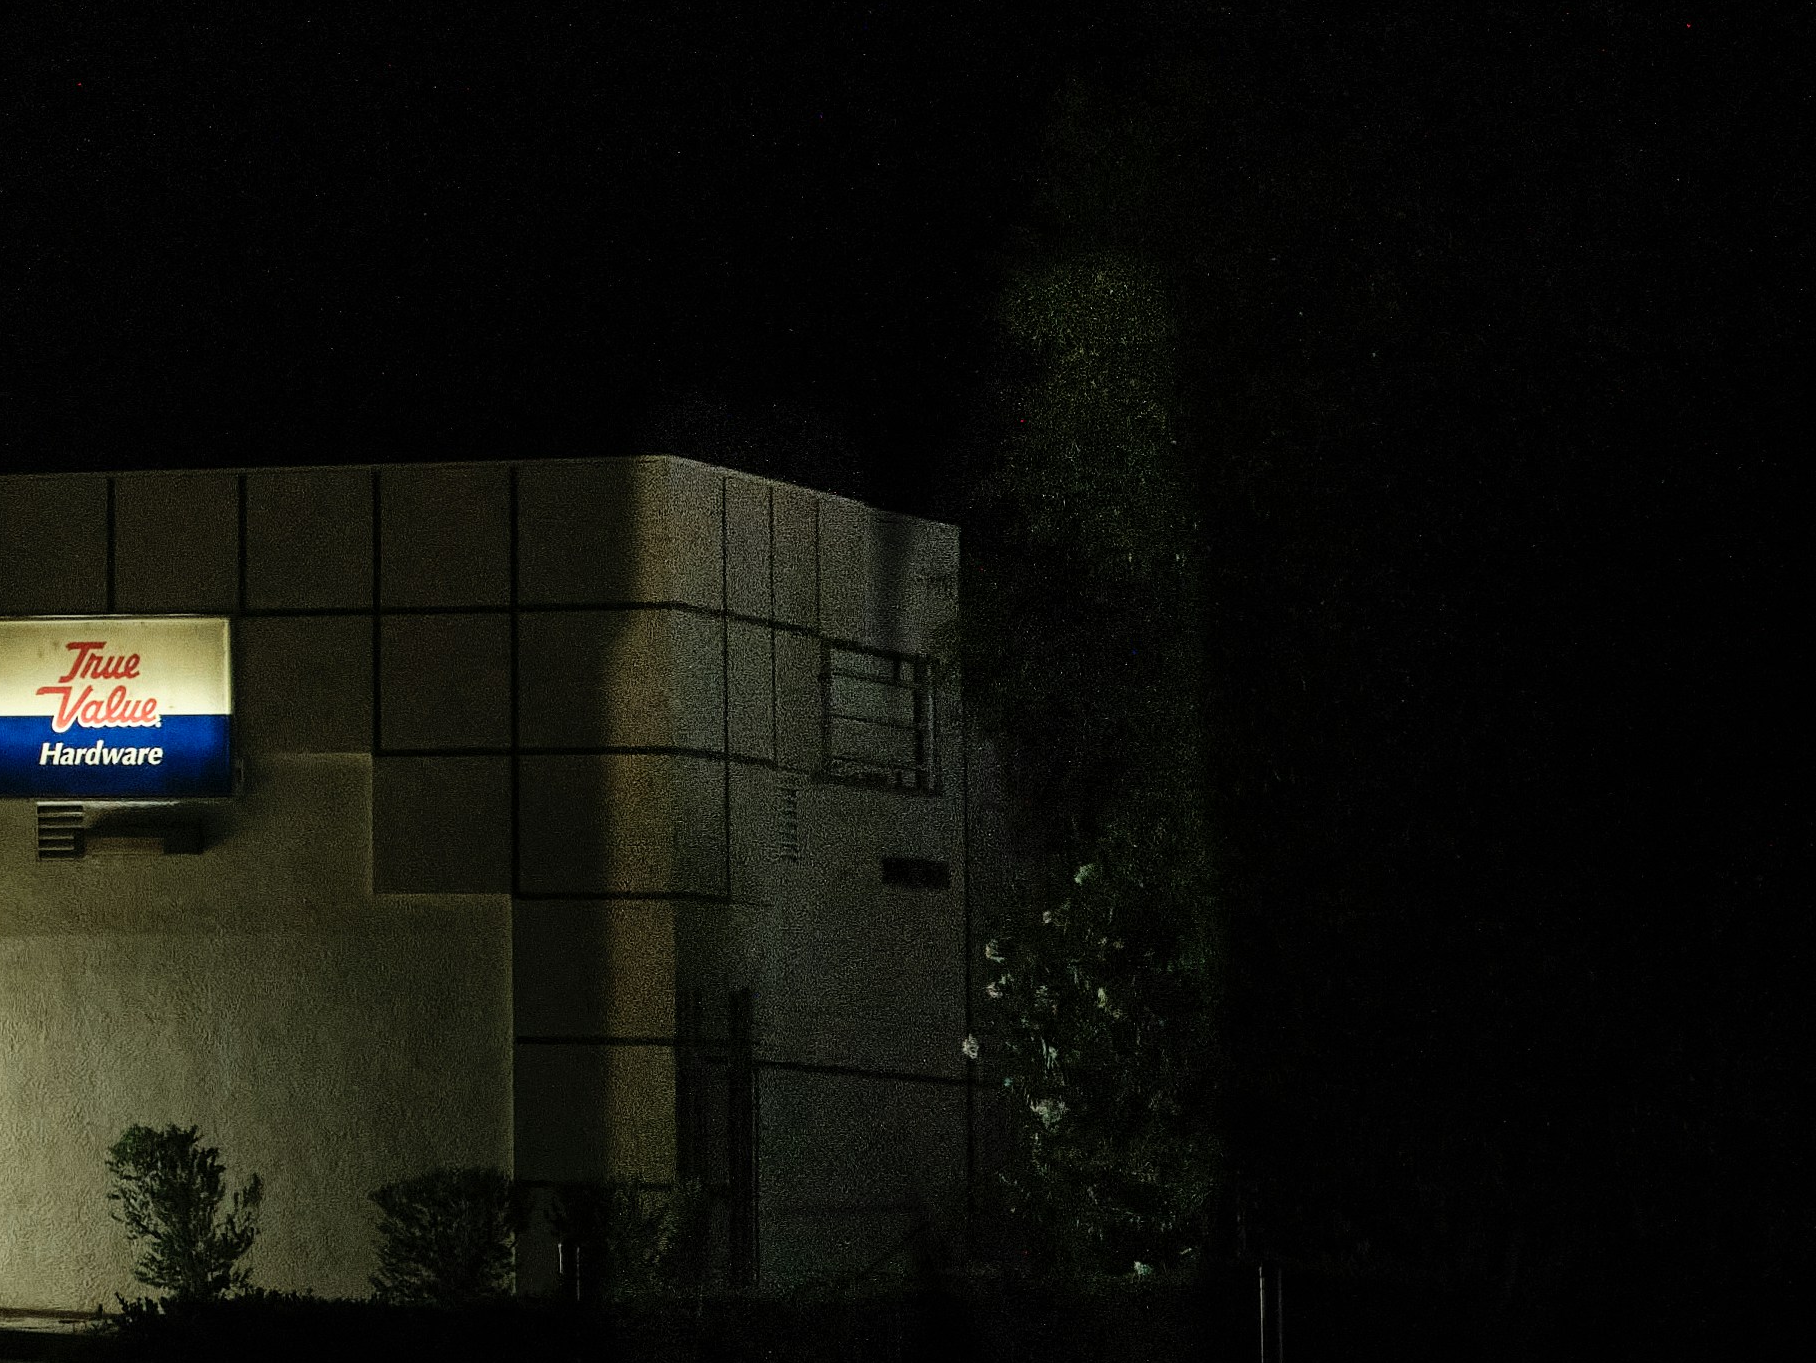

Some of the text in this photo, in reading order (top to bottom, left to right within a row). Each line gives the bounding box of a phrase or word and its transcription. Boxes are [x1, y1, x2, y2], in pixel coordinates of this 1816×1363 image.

[59, 641, 141, 684] True
[36, 685, 159, 732] Value
[39, 740, 163, 766] Hardware
